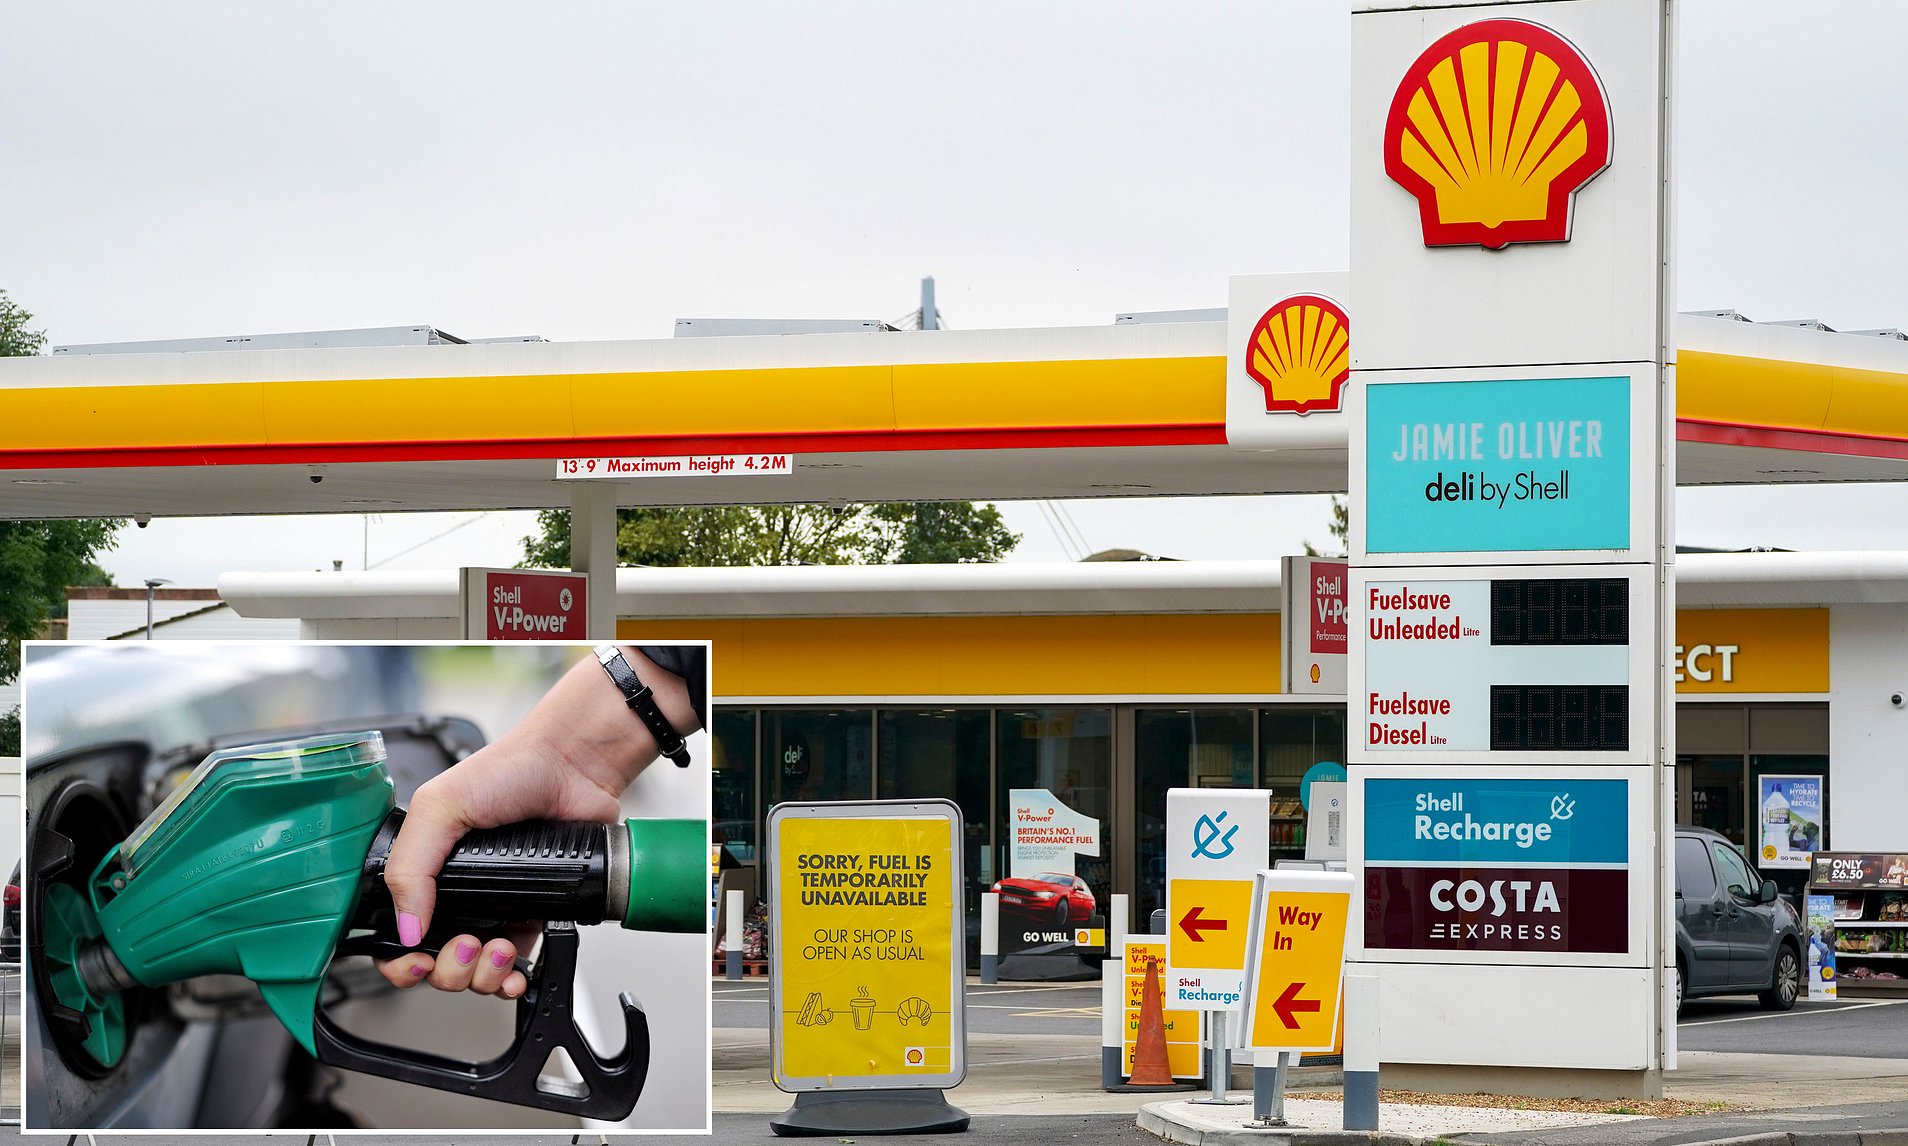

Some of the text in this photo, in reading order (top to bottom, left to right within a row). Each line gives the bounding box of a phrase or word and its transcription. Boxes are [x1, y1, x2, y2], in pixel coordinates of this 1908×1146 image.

[1392, 420, 1603, 462] JAMIE OLIVER
[607, 458, 681, 473] Maximum
[689, 456, 735, 474] height
[744, 455, 786, 470] 4.2M
[1425, 470, 1568, 510] deli by Shell
[493, 585, 521, 604] Shell
[1316, 575, 1341, 596] Shell
[1370, 586, 1451, 611] Fuelsave
[493, 606, 567, 633] V-Power
[1316, 597, 1348, 625] V-Po
[1316, 628, 1347, 641] Performance
[1370, 616, 1480, 640] Unleaded Litre
[1369, 691, 1451, 715] Fuelsave
[1369, 721, 1447, 745] Diesel Litre
[1415, 792, 1463, 812] Shell
[1017, 836, 1093, 844] PERFORMANCE FUEL
[1415, 813, 1552, 849] Recharge
[797, 854, 932, 872] SORRY, FUEL IS
[1832, 859, 1863, 870] ONLY
[800, 872, 928, 888] TEMPORARILY
[1831, 869, 1864, 880] £6.50
[801, 890, 927, 906] UNAVAILABLE
[1429, 879, 1561, 917] COSTA
[1279, 906, 1323, 931] Way
[814, 929, 914, 943] OUR SHOP IS
[1023, 931, 1069, 942] GO WELL
[1273, 931, 1293, 951] In
[1450, 923, 1561, 941] EXPRESS
[802, 946, 925, 961] OPEN AS USUAL
[1179, 978, 1201, 987] Shell
[1178, 988, 1240, 1004] Recharge
